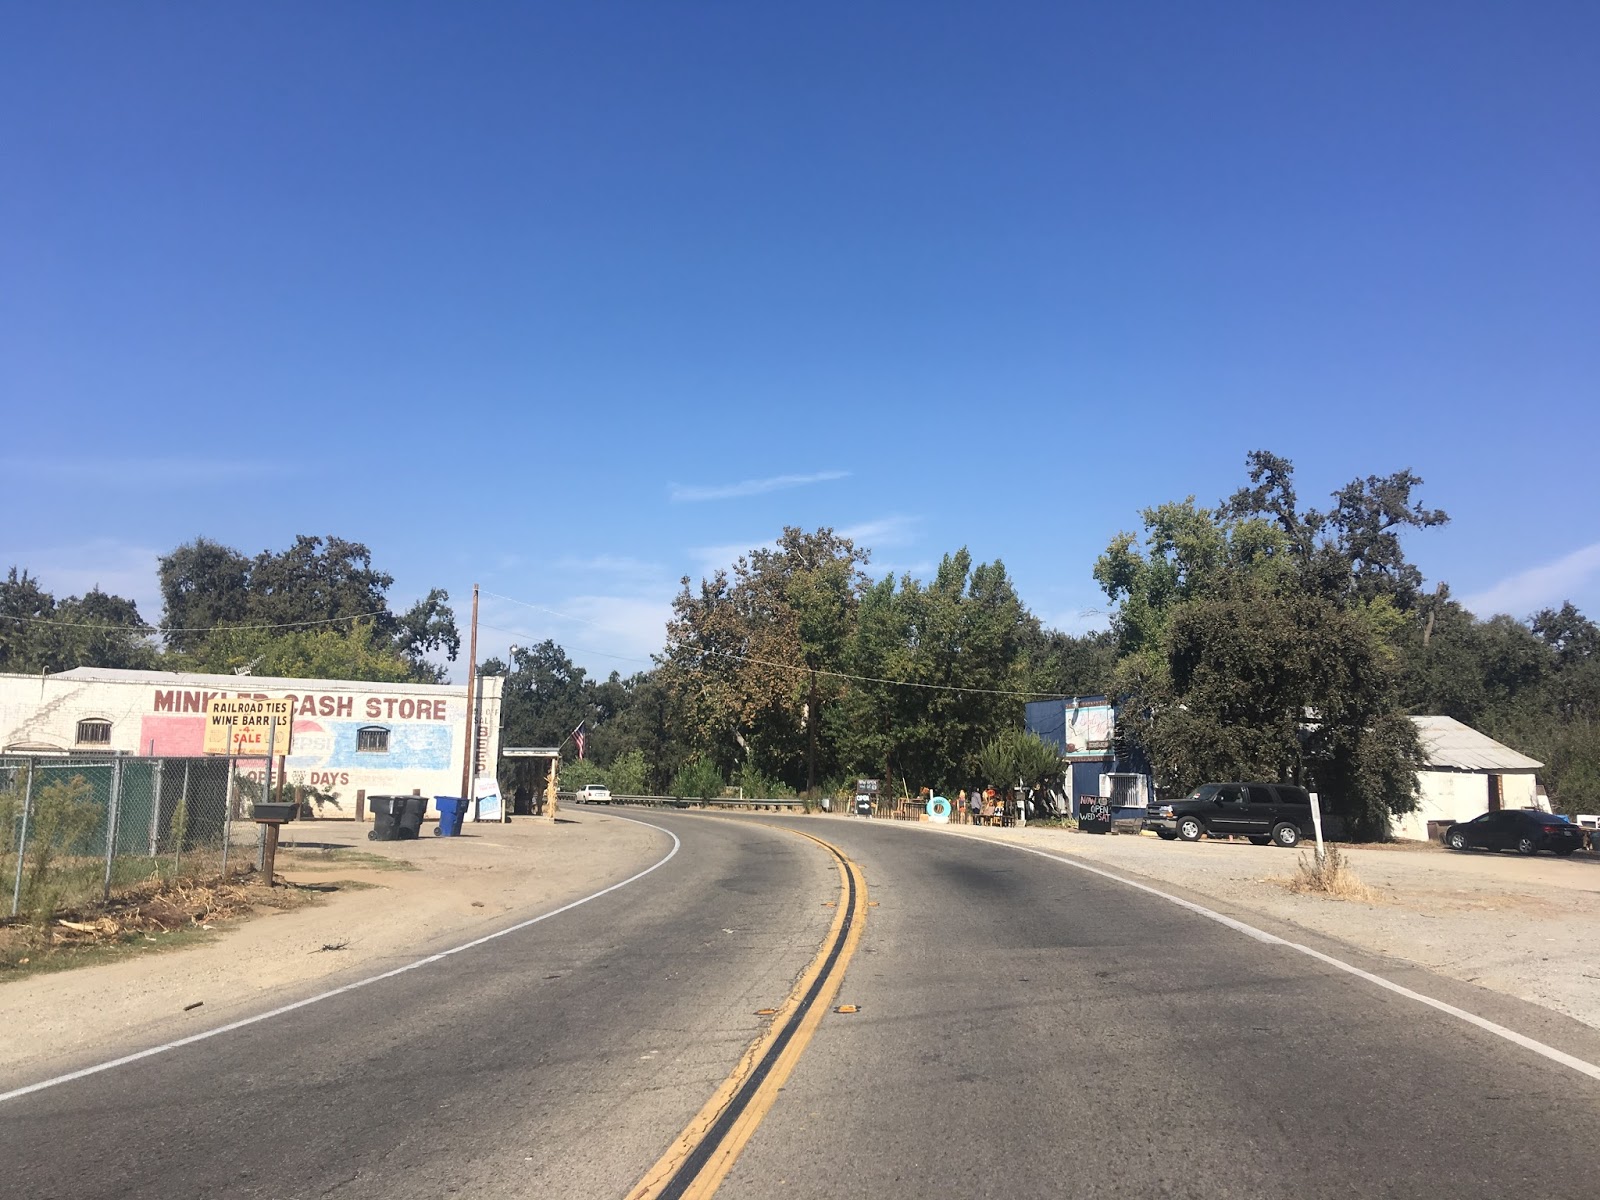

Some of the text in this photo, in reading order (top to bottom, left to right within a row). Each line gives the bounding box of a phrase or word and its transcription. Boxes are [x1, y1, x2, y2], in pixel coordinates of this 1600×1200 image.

[154, 690, 268, 712] MINK
[366, 698, 446, 720] STORE
[213, 703, 287, 713] RAILROAD TIES
[212, 716, 287, 725] WINE BARRLS
[233, 734, 261, 743] SALE
[311, 772, 349, 785] DAYS
[1080, 796, 1097, 805] NOW
[1090, 805, 1108, 814] OPEN
